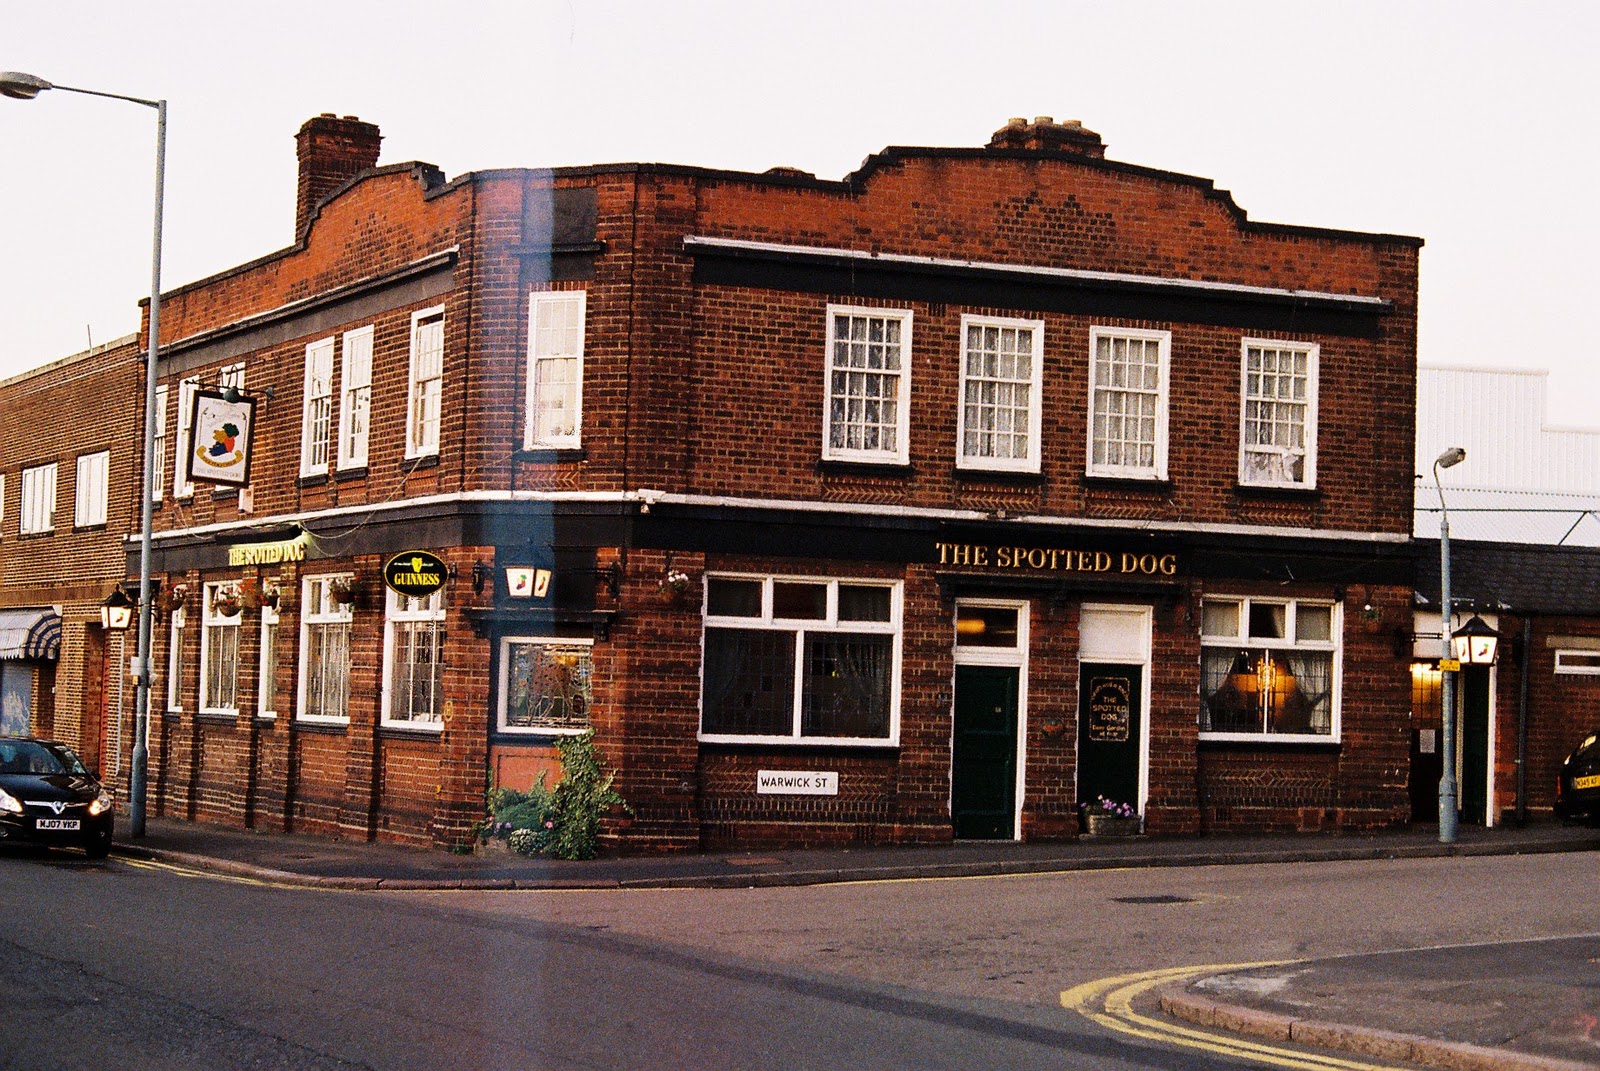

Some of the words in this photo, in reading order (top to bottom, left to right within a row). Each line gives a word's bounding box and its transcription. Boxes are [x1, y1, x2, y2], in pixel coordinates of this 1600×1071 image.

[228, 548, 245, 566] THE
[245, 545, 282, 565] SPOTTED
[283, 542, 305, 562] DOG
[936, 543, 988, 566] THE
[997, 547, 1112, 572] SPOTTED
[1121, 553, 1177, 575] DOG
[394, 573, 440, 585] GUINNESS
[1092, 704, 1127, 712] SPOTTED
[760, 777, 810, 788] WARWICK
[815, 778, 828, 788] ST
